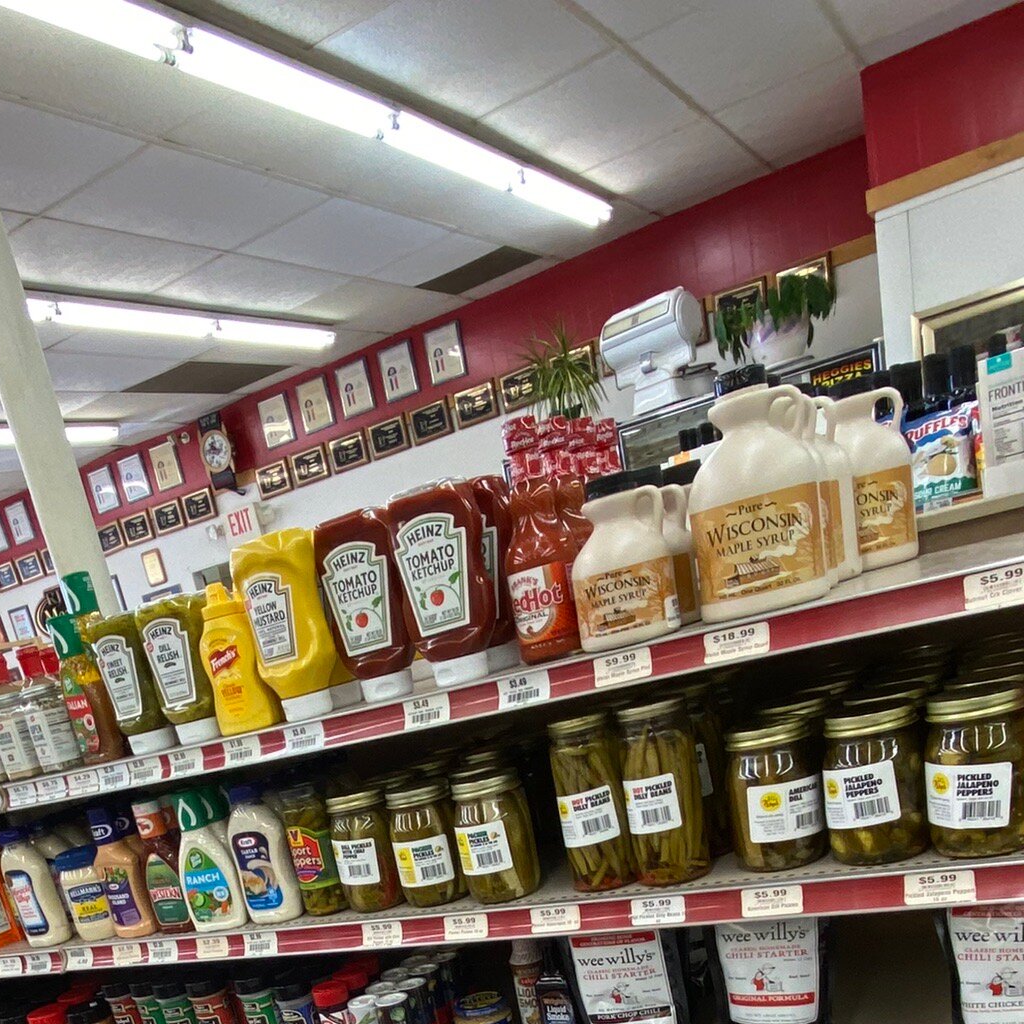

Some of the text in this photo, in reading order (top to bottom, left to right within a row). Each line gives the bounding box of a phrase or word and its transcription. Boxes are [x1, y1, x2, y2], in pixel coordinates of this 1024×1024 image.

[812, 358, 872, 387] HEGGIES
[856, 489, 899, 506] ONSIN
[738, 501, 764, 516] Pure
[860, 503, 892, 517] SYRUP
[228, 508, 251, 537] EXIT
[406, 524, 442, 547] HEINZ
[706, 511, 803, 548] WISCONSIN
[716, 529, 795, 559] MAPLE SYRUP
[332, 551, 366, 572] HEINZ
[405, 544, 455, 571] TOMATO
[411, 559, 455, 582] KETCHUP
[605, 571, 623, 581] Pure
[980, 568, 1023, 585] $5.99
[332, 571, 378, 594] TOMATO
[512, 575, 538, 593] FRANK'S
[584, 575, 651, 601] WISCONSIN
[249, 582, 273, 599] HEINZ
[337, 584, 378, 605] KETCHUP
[513, 583, 563, 612] edHot
[591, 589, 647, 609] MAPLE SYRUP
[254, 601, 277, 616] YELLOW
[150, 626, 173, 640] HEINZ
[713, 628, 756, 644] $18.99
[101, 643, 120, 656] HEINZ
[158, 643, 172, 653] DILL
[156, 650, 180, 664] RELISH
[210, 649, 238, 672] French's
[605, 653, 636, 667] $9.99
[108, 666, 128, 679] RELISH
[509, 676, 527, 689] $3.49
[843, 773, 874, 785] PICKLED
[957, 773, 992, 781] PICKLED
[644, 780, 672, 793] PICKLED
[844, 778, 883, 792] JALAPENO
[957, 780, 999, 789] JALAPENO
[584, 790, 610, 803] PICKLED
[633, 786, 672, 800] DILLY BEANS
[846, 786, 879, 798] PEPPERS
[956, 788, 993, 797] PEPPERS
[590, 796, 611, 808] BEANS
[789, 795, 803, 803] DILL
[292, 846, 312, 857] port
[351, 841, 373, 849] PICKLES
[294, 857, 322, 868] ppers
[186, 872, 220, 886] RANCH
[919, 874, 957, 885] $5.99
[754, 889, 787, 899] $5.99
[82, 904, 98, 912] REAL
[642, 899, 671, 909] $5.99
[540, 908, 566, 917] $5.99
[452, 917, 475, 925] $5.99
[721, 922, 806, 943] wee willy's
[955, 931, 990, 942] wee
[577, 947, 653, 967] wee willy's
[757, 949, 808, 959] STARTER
[957, 953, 991, 961] CHILI
[611, 968, 657, 980] STARTER
[768, 994, 809, 1002] FORMULA
[546, 1005, 567, 1013] Liquid
[639, 1007, 661, 1015] CHILI
[547, 1012, 570, 1021] Smoke
